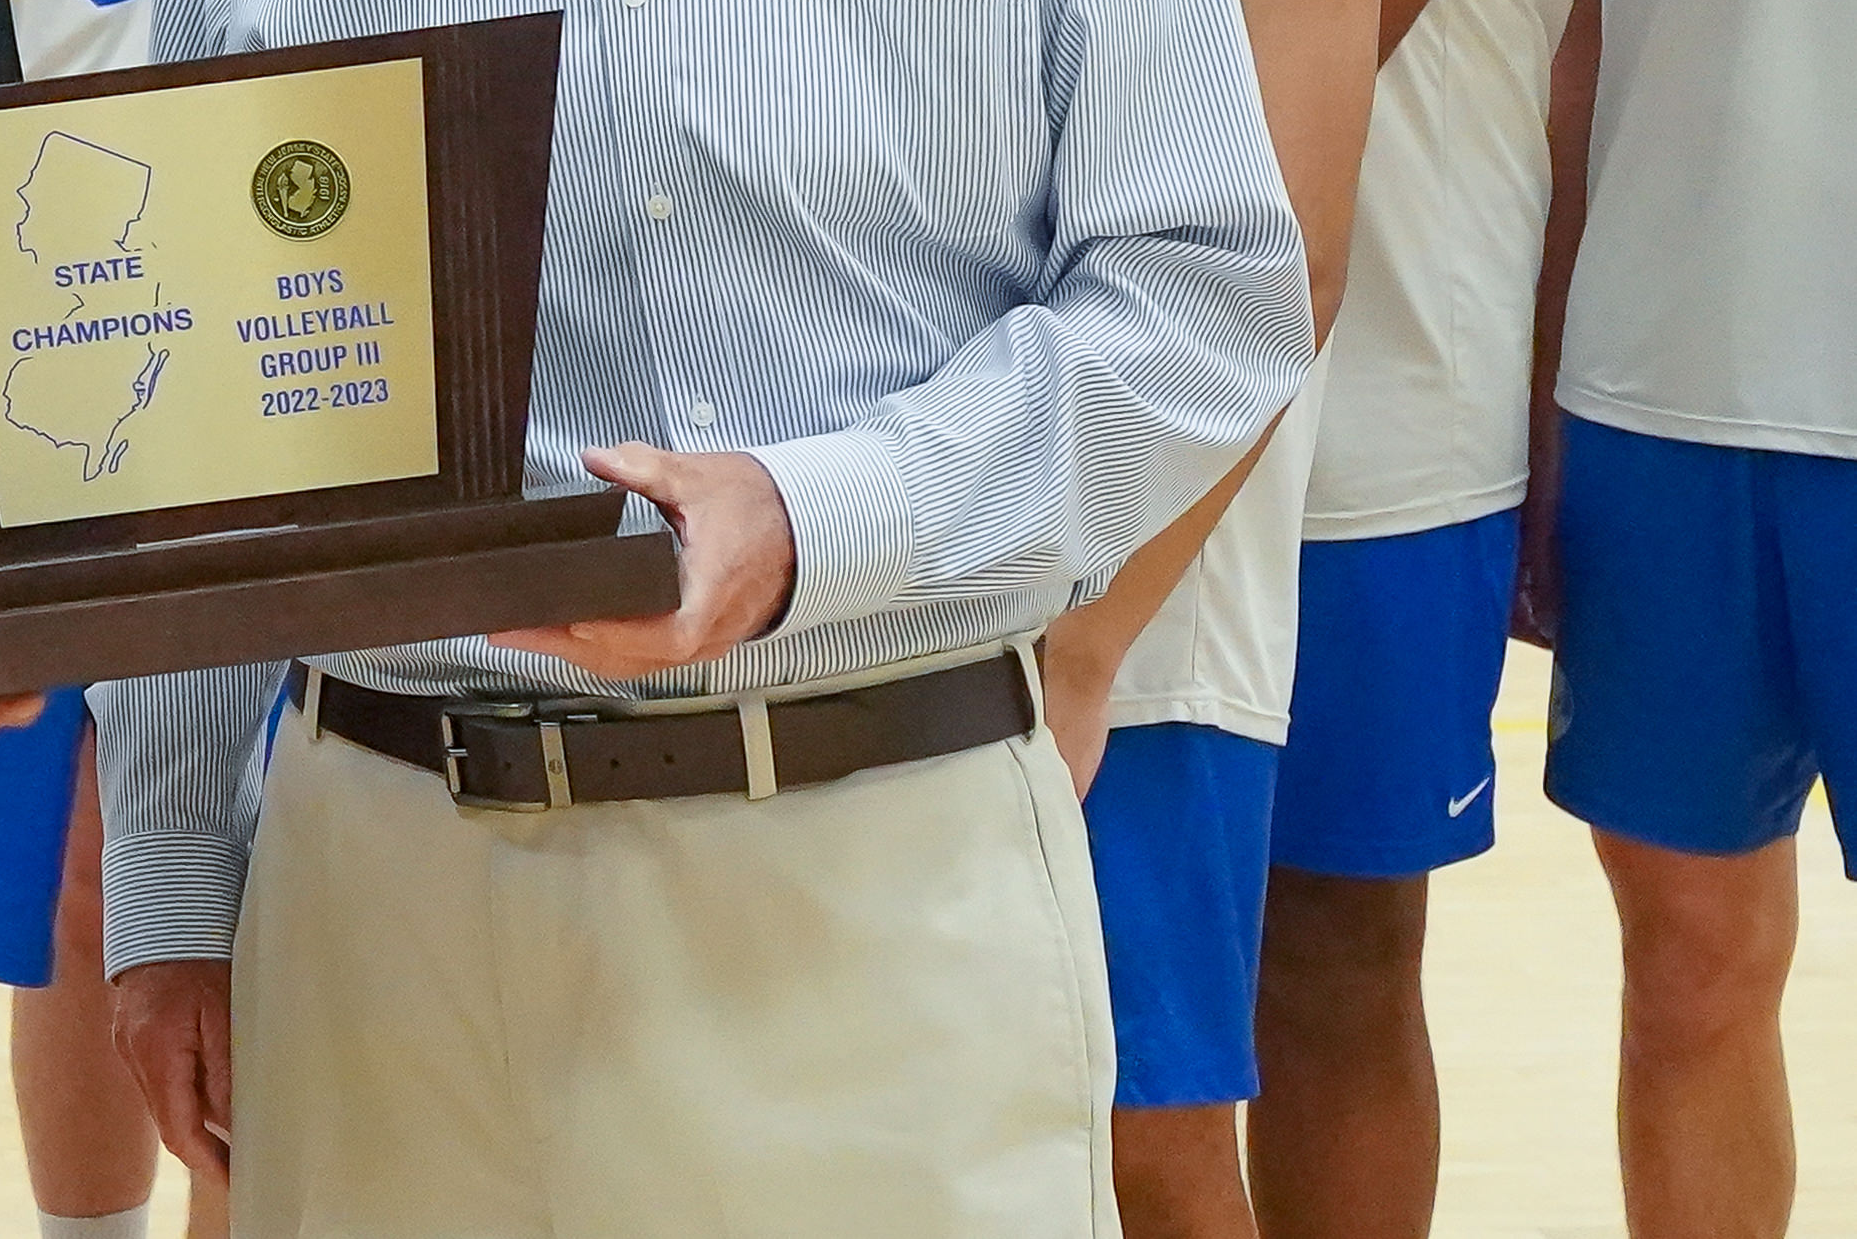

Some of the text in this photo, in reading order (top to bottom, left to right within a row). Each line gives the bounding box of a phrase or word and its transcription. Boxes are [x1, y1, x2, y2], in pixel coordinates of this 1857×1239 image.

[319, 175, 330, 200] 1918
[54, 256, 144, 288] STATE
[277, 269, 345, 300] BOYS
[12, 308, 193, 352] CHAMPIONS
[236, 302, 395, 343] VOLLEYBALL
[260, 341, 380, 379] GROUP III
[261, 378, 389, 417] 2022-2023
